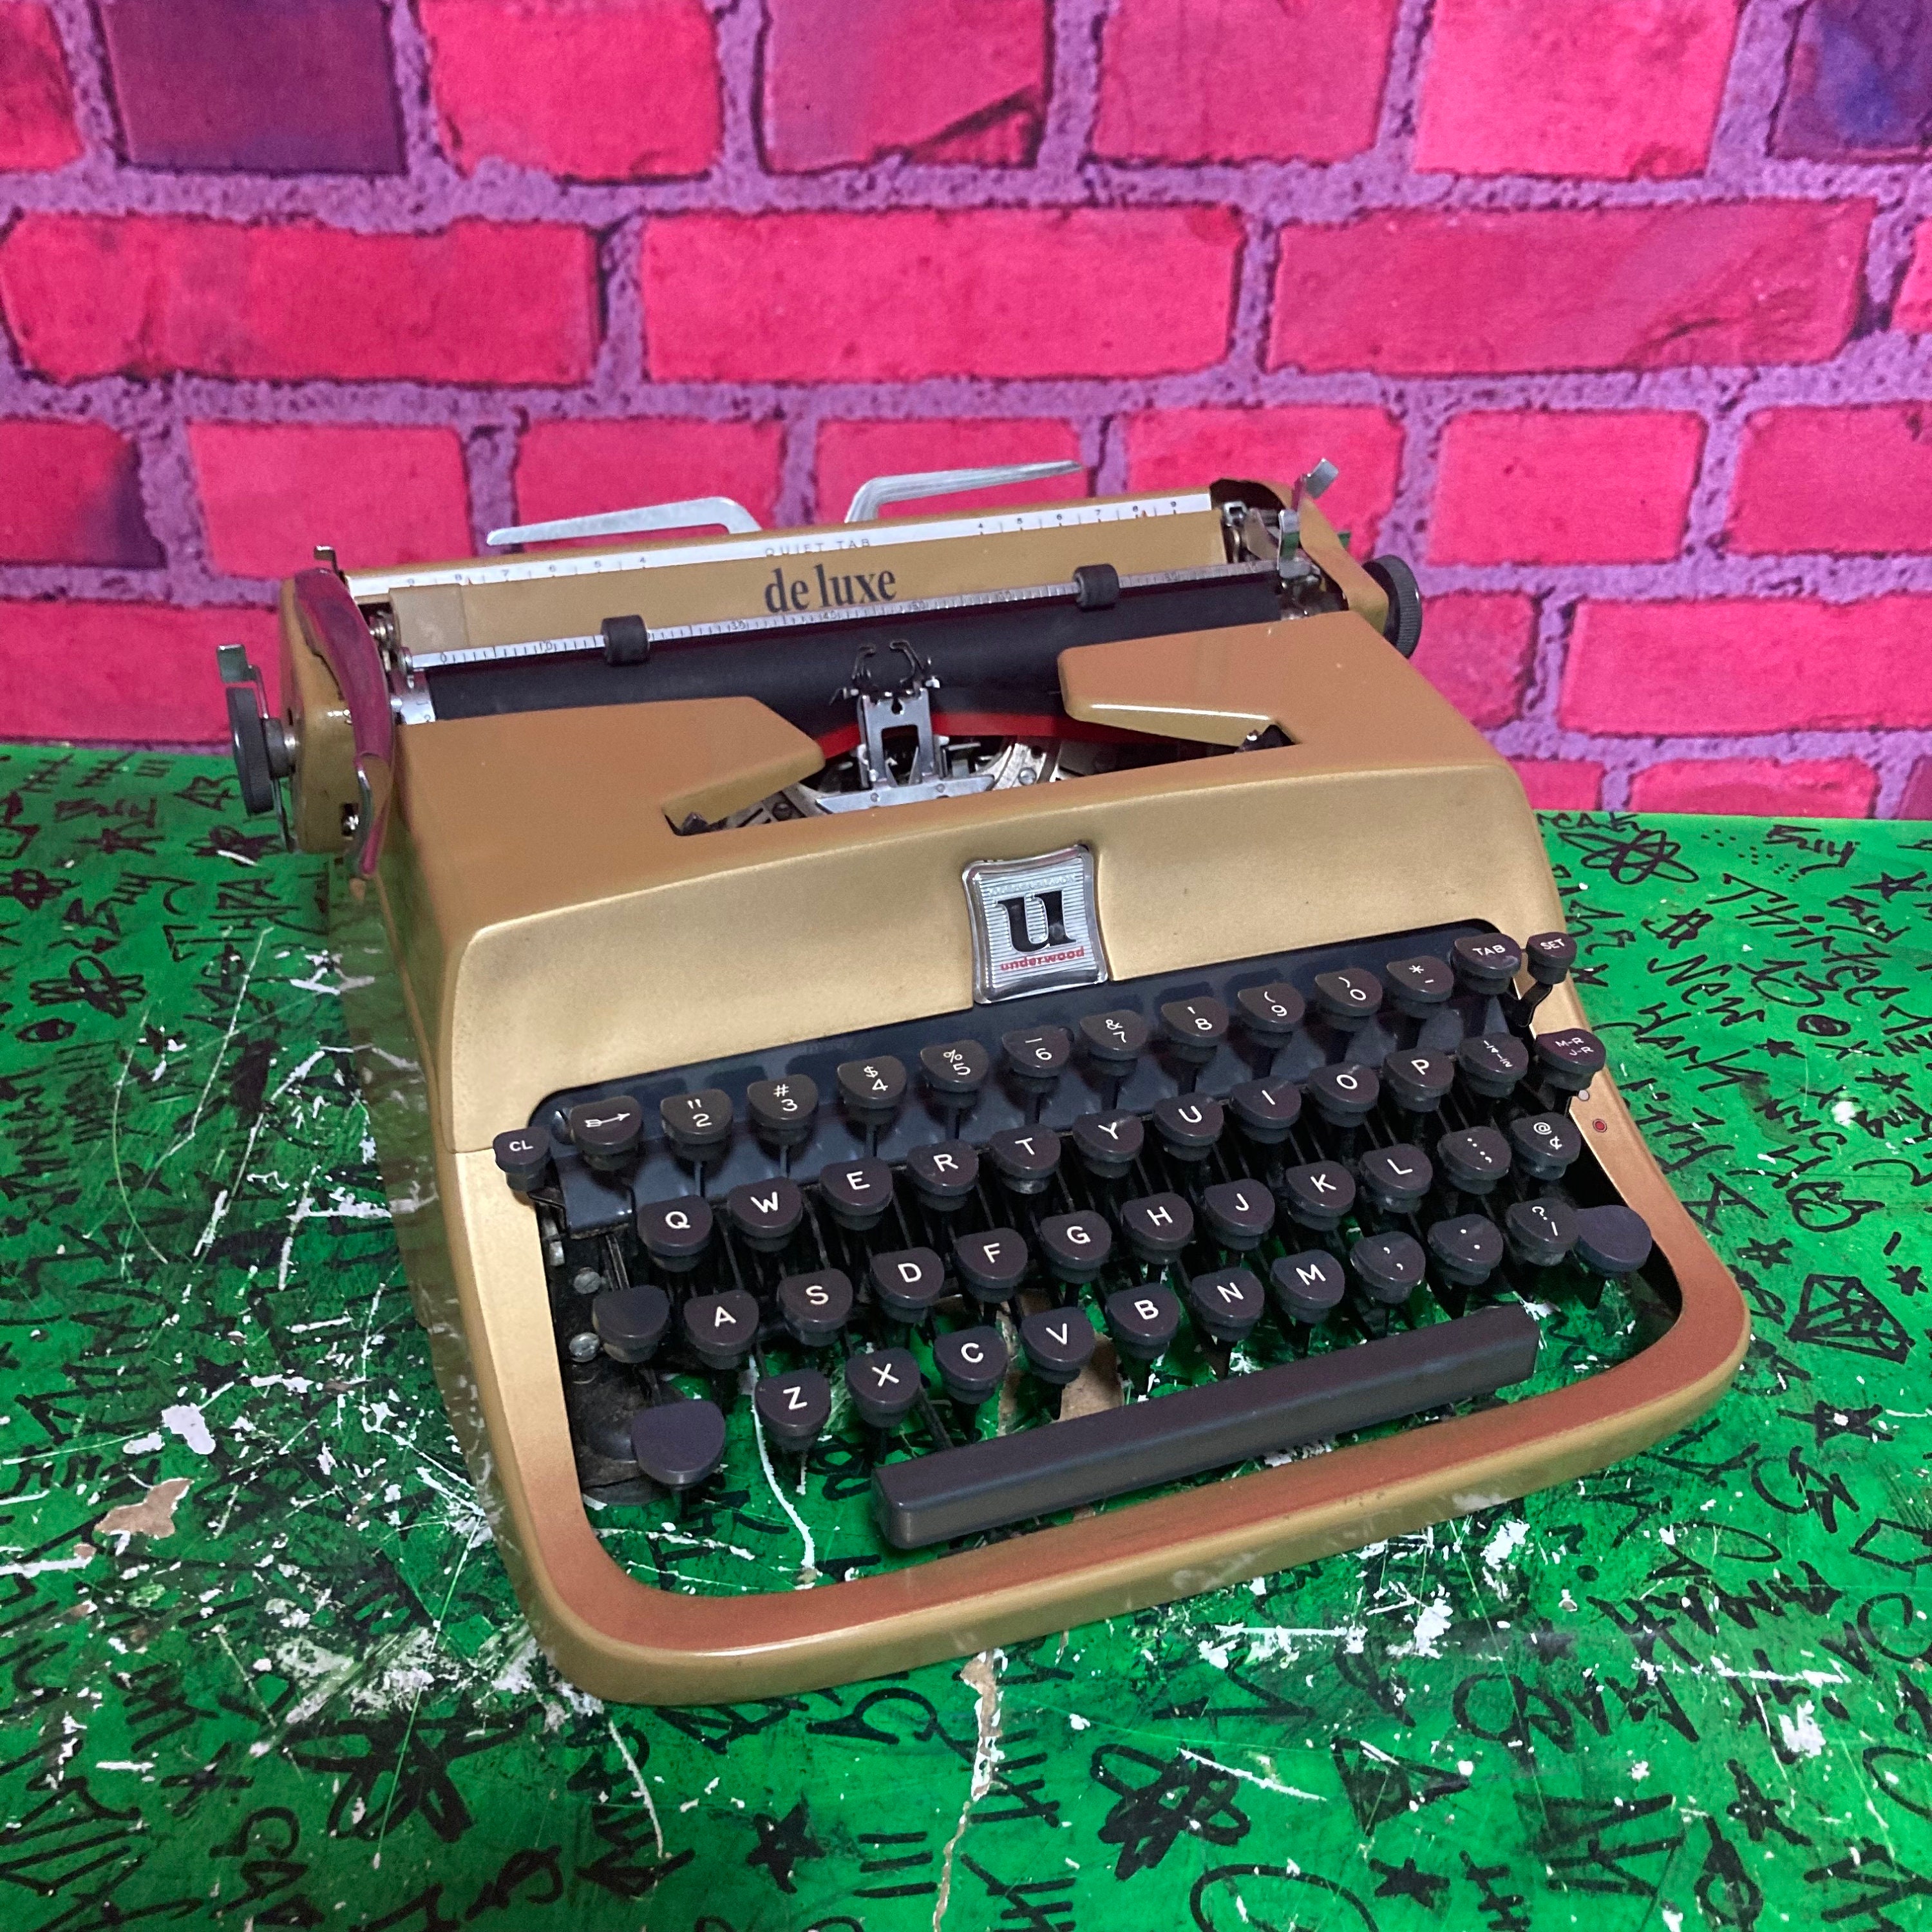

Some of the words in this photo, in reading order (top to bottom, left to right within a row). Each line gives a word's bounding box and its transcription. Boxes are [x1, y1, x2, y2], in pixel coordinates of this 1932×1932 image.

[764, 542, 824, 558] QUIET
[837, 538, 870, 549] TAB
[764, 567, 811, 614] de
[813, 563, 898, 609] luxe
[1472, 944, 1506, 956] TAB
[1540, 938, 1565, 950] SET
[999, 945, 1085, 972] underwood
[1271, 1005, 1287, 1017] 9
[1195, 1018, 1213, 1030] 8
[1112, 1030, 1127, 1043] 7
[1035, 1047, 1052, 1061] 6
[952, 1062, 971, 1075] 5
[1410, 1059, 1430, 1075] P
[871, 1078, 889, 1092] 4
[1336, 1073, 1358, 1090] O
[781, 1098, 798, 1112] 3
[1178, 1105, 1202, 1123] U
[692, 1113, 712, 1128] 2
[1533, 1122, 1553, 1135] @
[1097, 1122, 1119, 1140] Y
[509, 1140, 534, 1152] CL
[1014, 1137, 1035, 1155] T
[933, 1153, 959, 1172] R
[1387, 1159, 1413, 1175] L
[846, 1171, 871, 1190] E
[1310, 1173, 1337, 1193] K
[750, 1191, 779, 1213] W
[1235, 1193, 1249, 1211] J
[665, 1211, 691, 1229] Q
[1146, 1206, 1173, 1226] H
[1066, 1226, 1091, 1244] G
[983, 1242, 1001, 1264] F
[897, 1262, 922, 1283] D
[1296, 1264, 1327, 1285] M
[805, 1285, 829, 1305] S
[1217, 1282, 1244, 1303] N
[714, 1306, 737, 1327] A
[1134, 1299, 1159, 1320] B
[1045, 1323, 1068, 1345] V
[960, 1342, 984, 1363] C
[871, 1363, 900, 1387] X
[782, 1386, 808, 1410] Z
